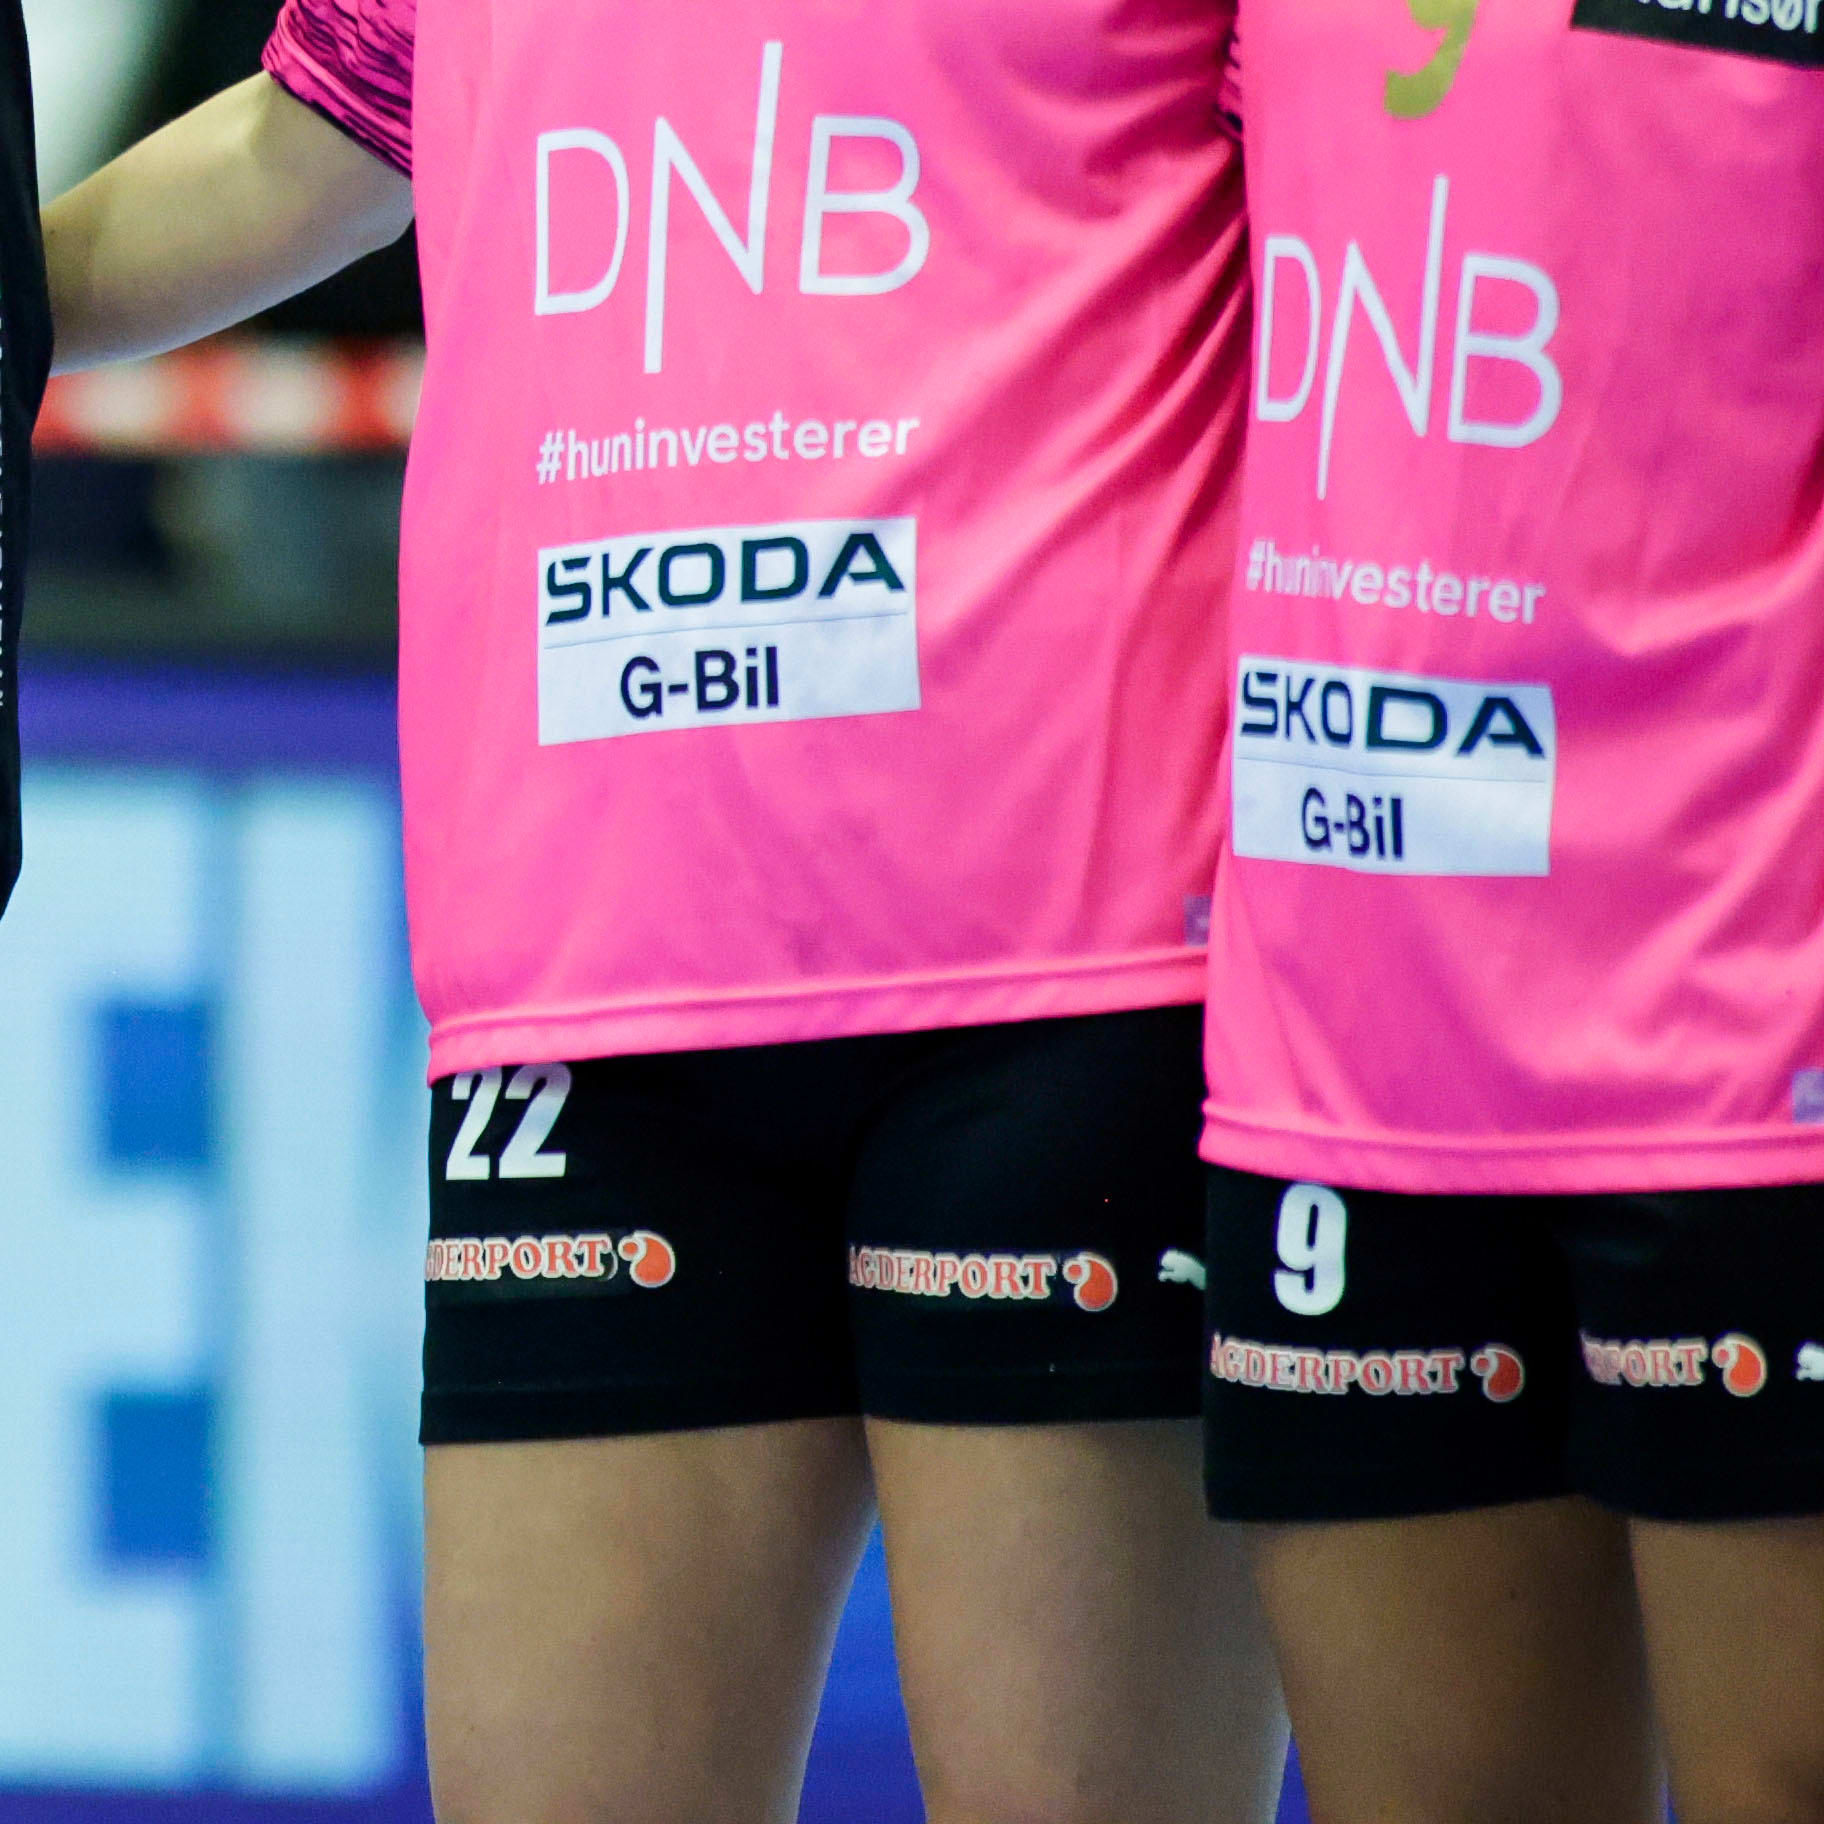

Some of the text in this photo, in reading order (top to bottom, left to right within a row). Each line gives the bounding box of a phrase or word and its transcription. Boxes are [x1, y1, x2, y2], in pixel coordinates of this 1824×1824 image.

[534, 40, 931, 374] DNB
[1256, 174, 1563, 500] DNB
[536, 411, 919, 486] #huninvesterer
[619, 645, 779, 719] G-Bil
[1302, 785, 1405, 861] G-Bil
[445, 1061, 574, 1181] 22
[1273, 1182, 1348, 1316] 9
